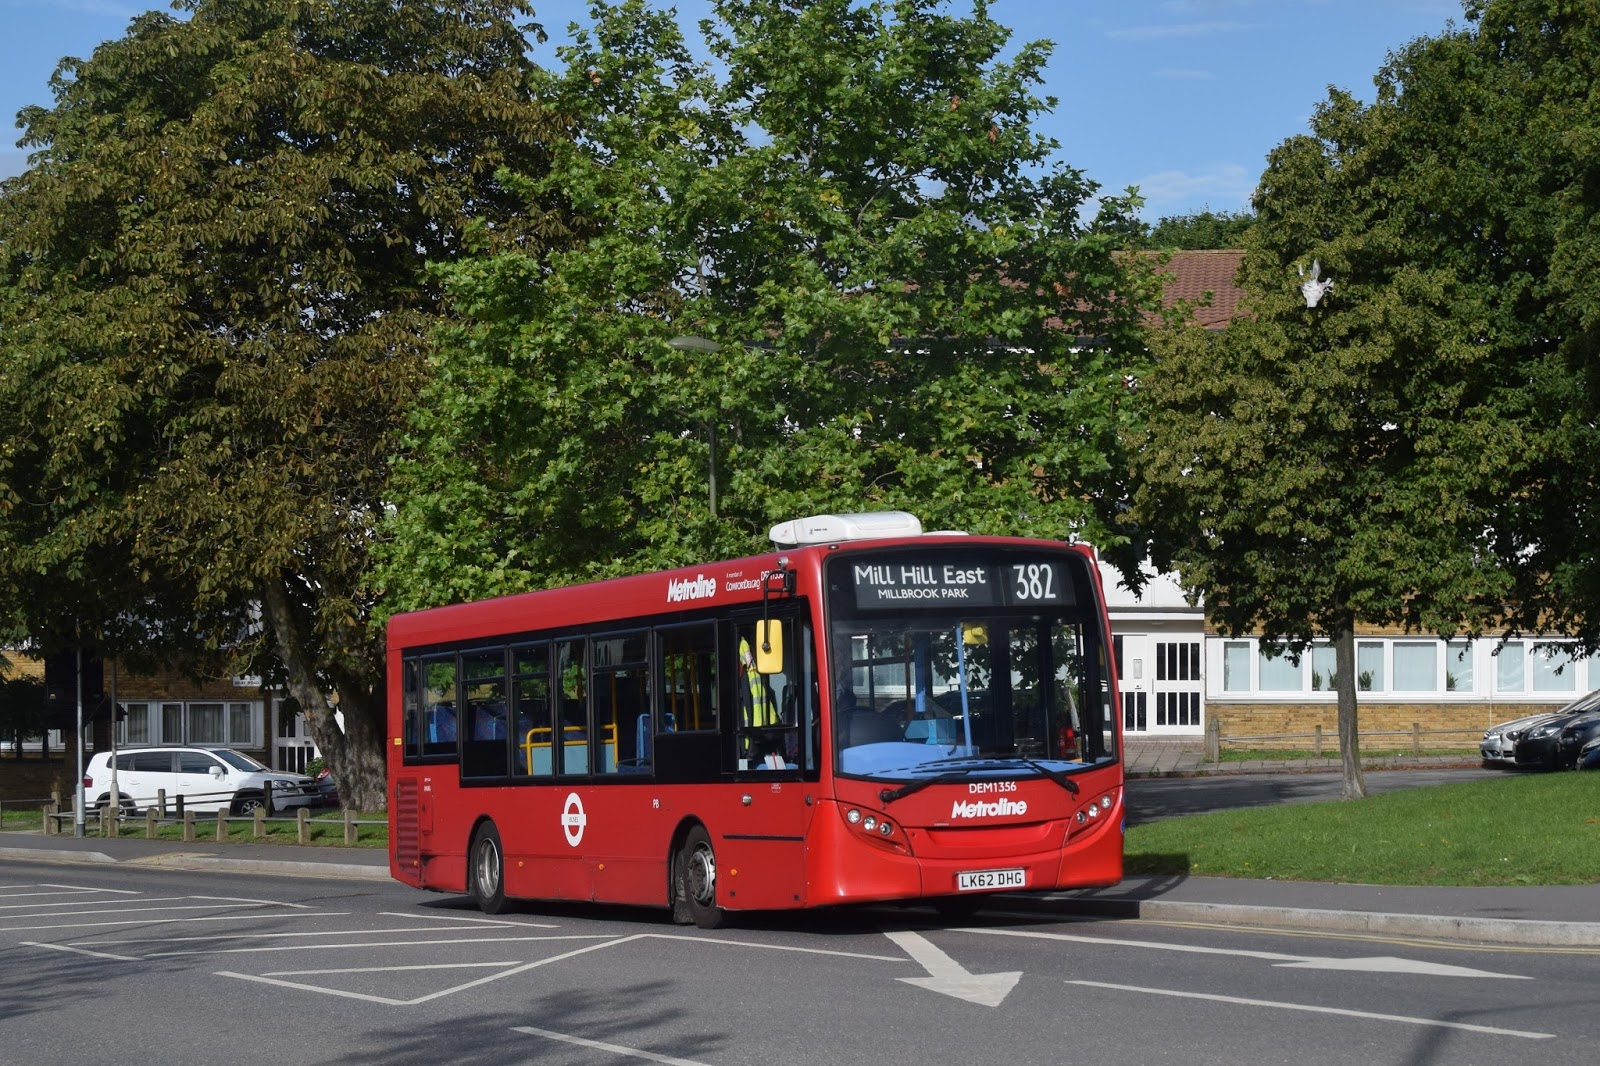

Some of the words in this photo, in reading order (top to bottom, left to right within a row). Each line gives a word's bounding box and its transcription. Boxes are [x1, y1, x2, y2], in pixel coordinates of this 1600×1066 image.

[854, 565, 895, 585] Mill
[901, 565, 938, 585] Hill
[944, 565, 986, 584] East
[1013, 563, 1057, 600] 382
[667, 574, 716, 603] Metroline
[878, 588, 939, 600] MILLBROOK
[942, 587, 969, 599] PARK
[969, 781, 1017, 794] DEM1356
[951, 798, 1027, 819] Metroline
[961, 873, 994, 888] LK62
[998, 872, 1022, 885] DHG
